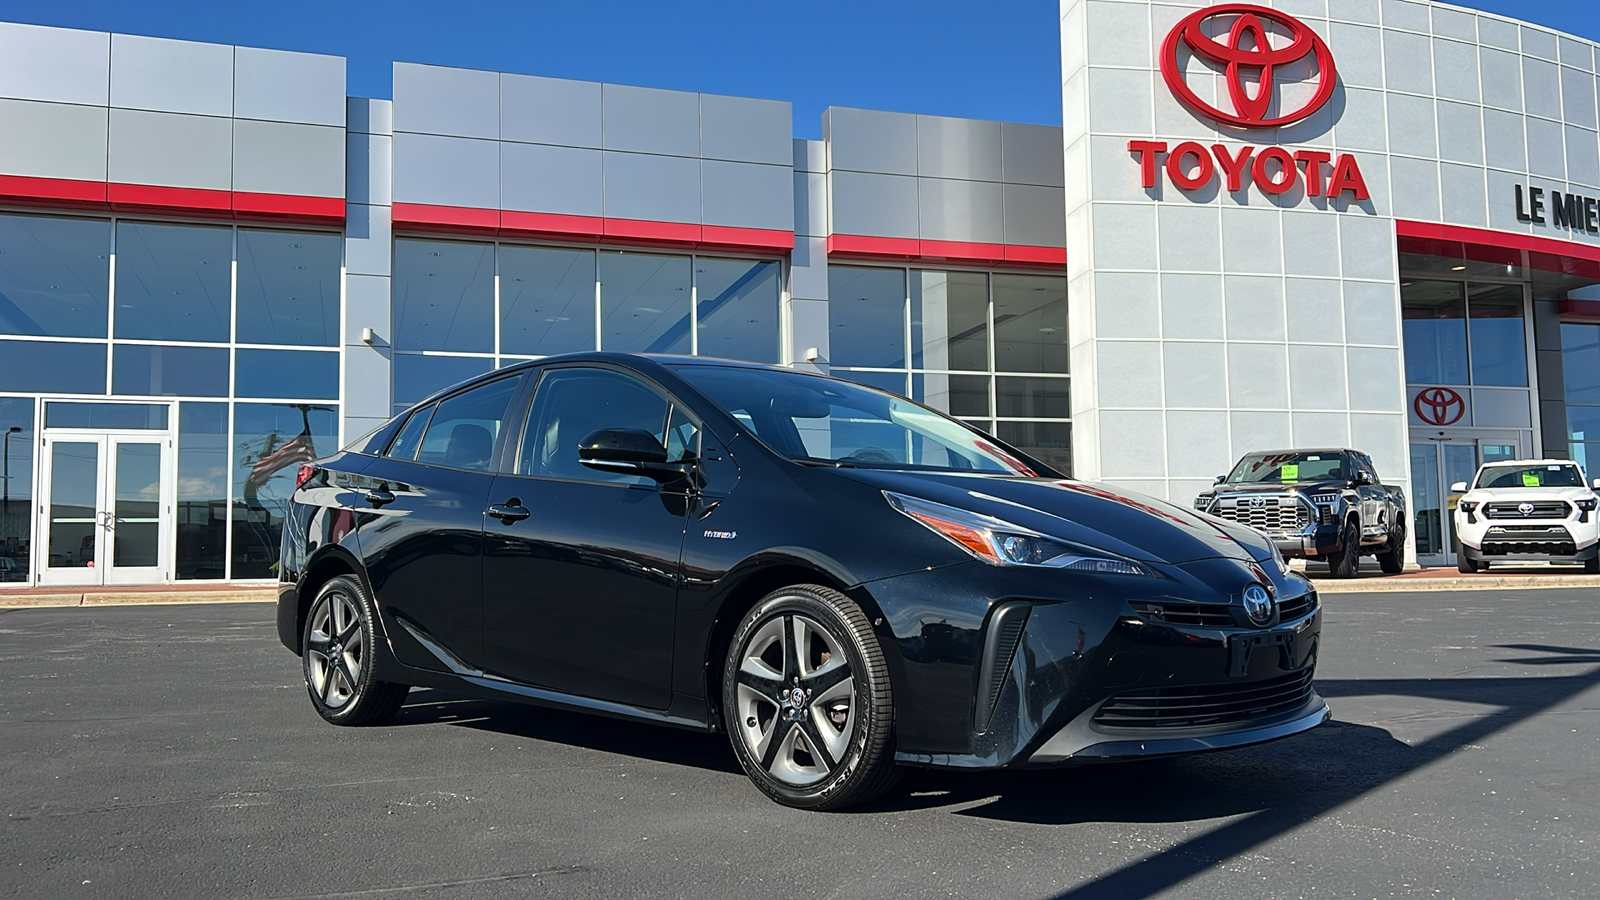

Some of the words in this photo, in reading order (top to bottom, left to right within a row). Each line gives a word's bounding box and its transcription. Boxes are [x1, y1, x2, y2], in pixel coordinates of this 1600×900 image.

[1127, 139, 1371, 201] TOYOTA
[1515, 183, 1545, 223] LE
[1551, 190, 1600, 232] MIE
[703, 530, 731, 539] HYBRID
